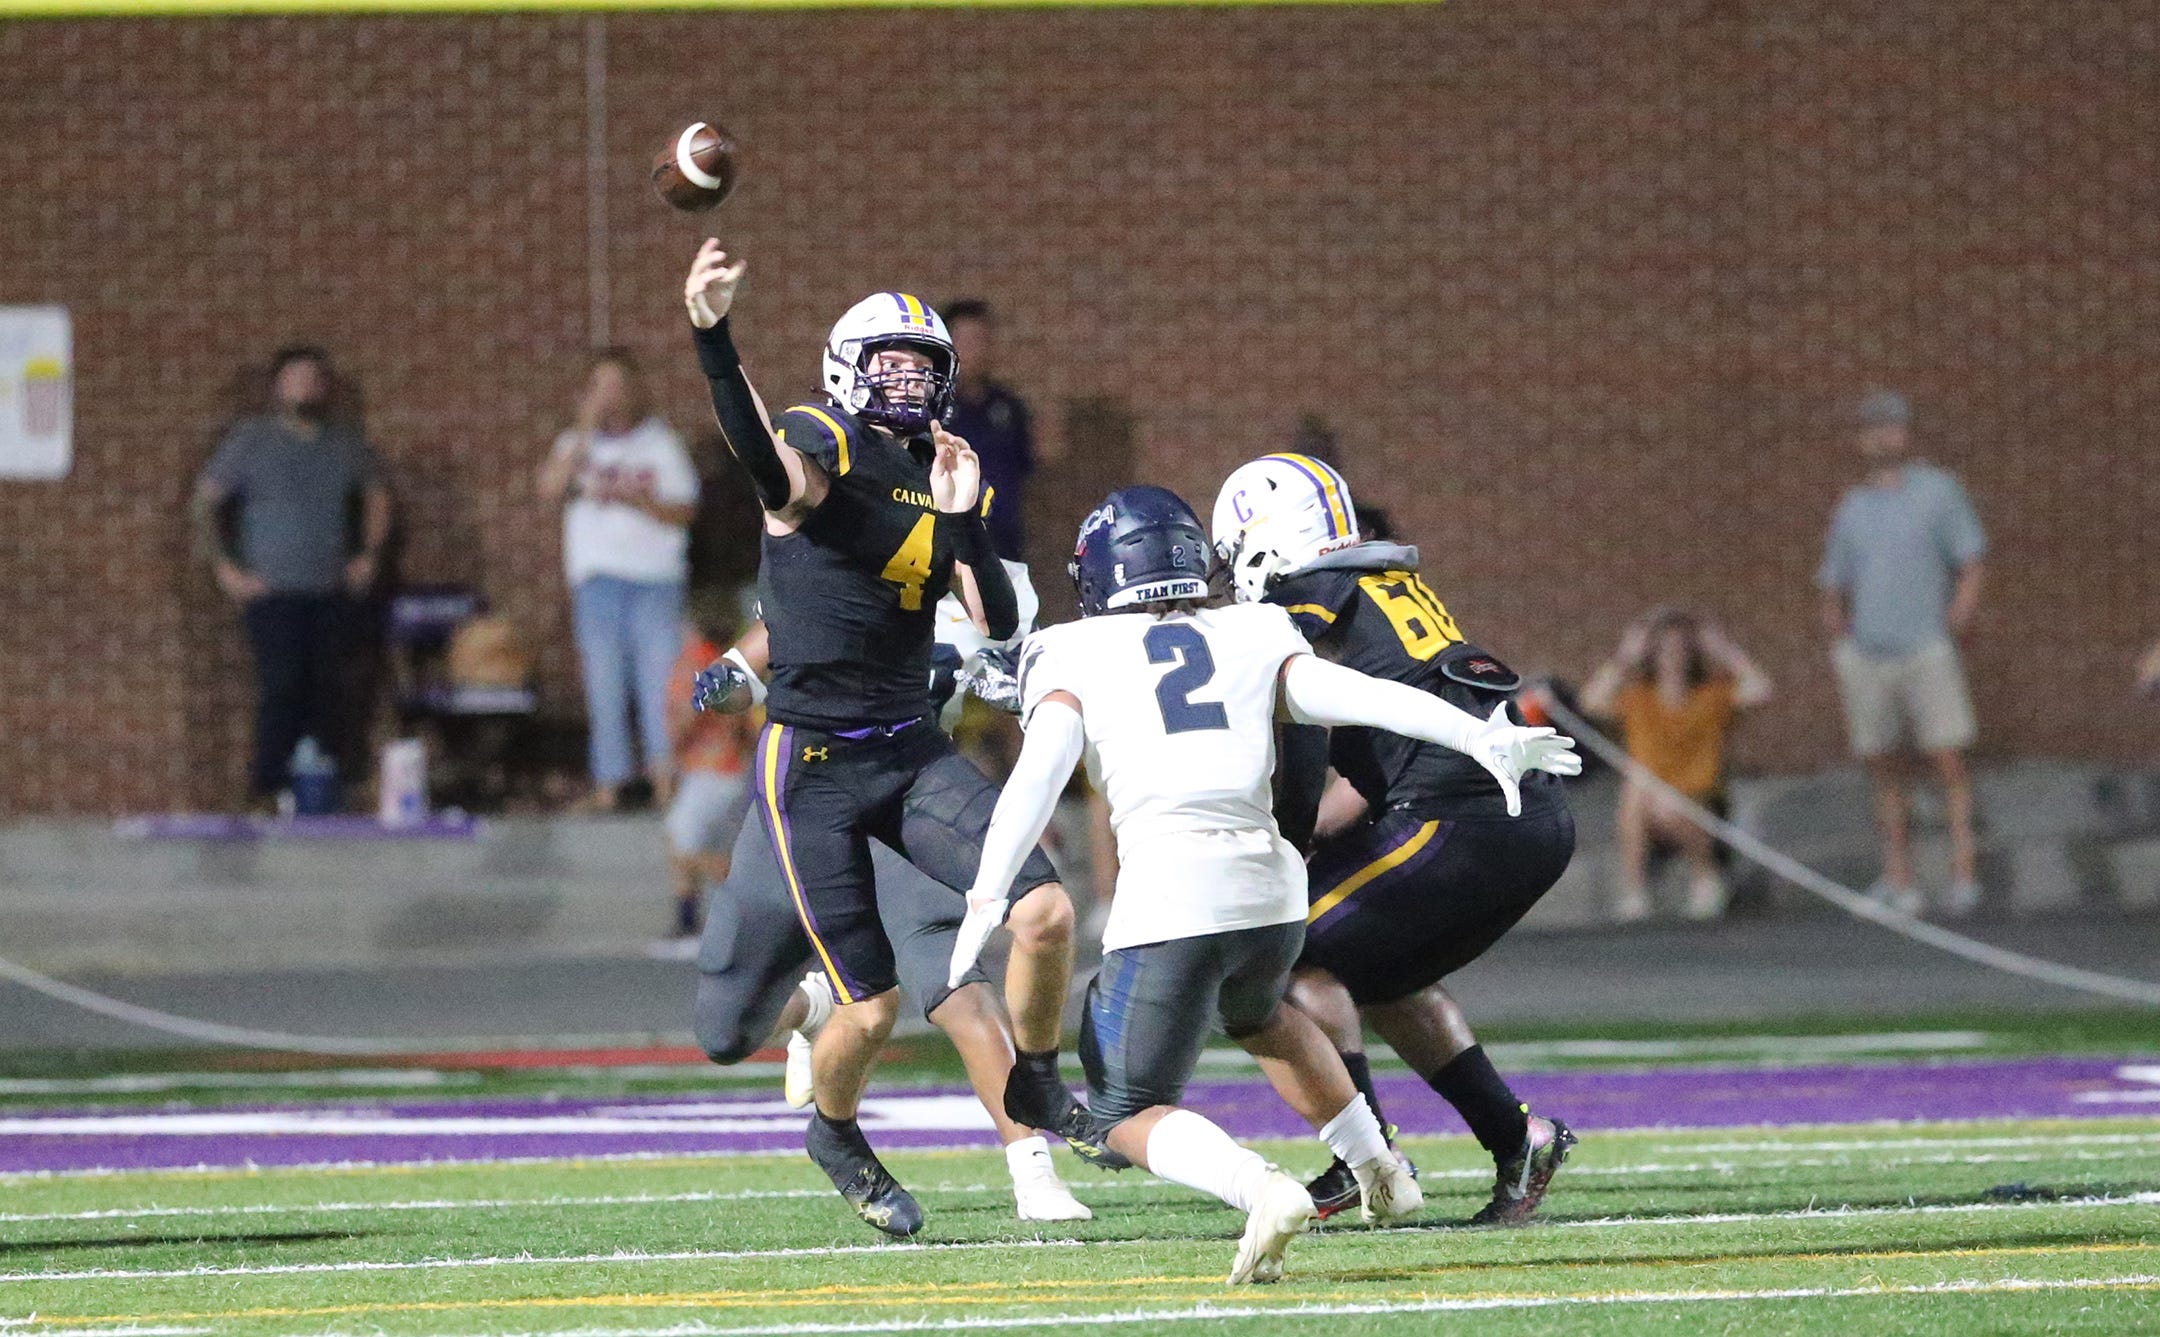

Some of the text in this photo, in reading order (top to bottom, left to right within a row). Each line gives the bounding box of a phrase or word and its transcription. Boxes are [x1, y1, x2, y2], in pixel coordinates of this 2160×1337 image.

[1232, 489, 1254, 524] C
[881, 512, 937, 611] 4
[1172, 545, 1186, 568] 2
[1136, 582, 1199, 600] TEAM FIRST
[1358, 570, 1464, 663] 60
[1143, 622, 1230, 735] 2
